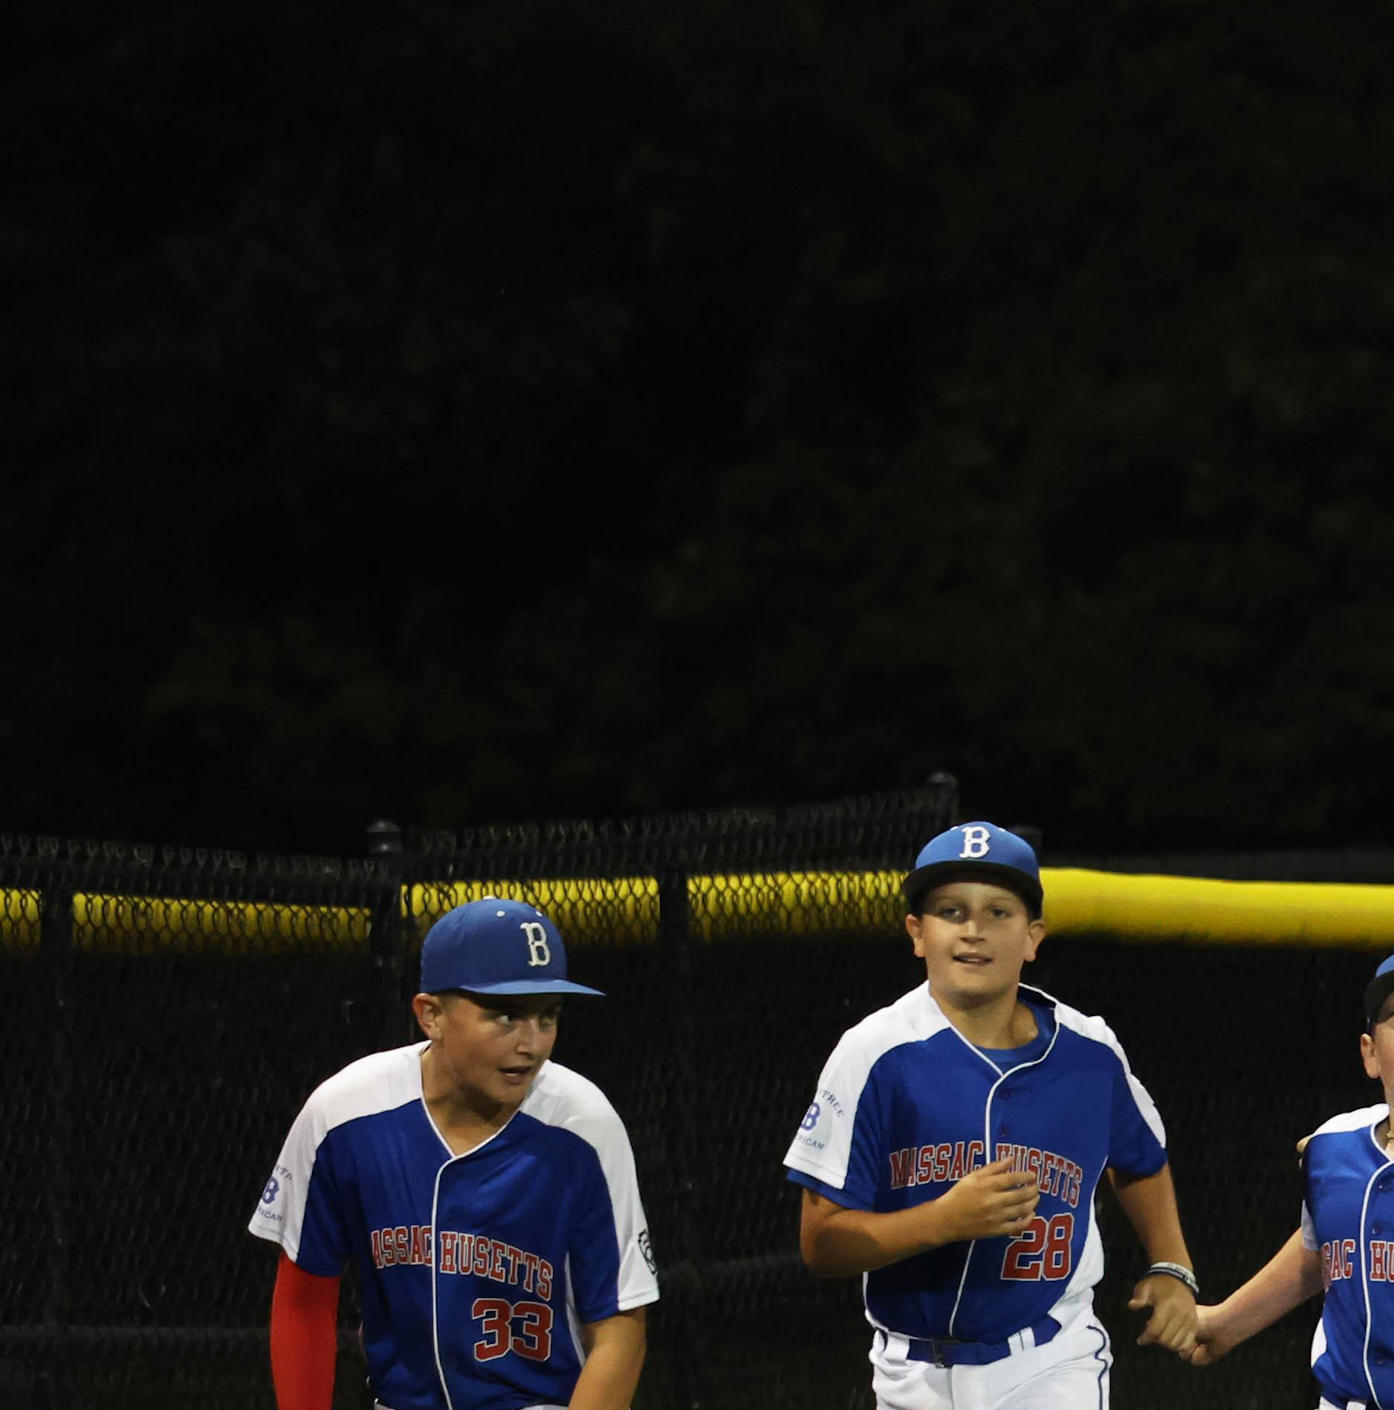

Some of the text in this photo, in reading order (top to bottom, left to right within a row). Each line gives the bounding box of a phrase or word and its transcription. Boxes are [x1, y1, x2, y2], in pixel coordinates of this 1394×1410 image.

[959, 826, 991, 858] B
[520, 922, 551, 967] B
[1000, 1212, 1075, 1281] 28
[472, 1297, 553, 1363] 33
